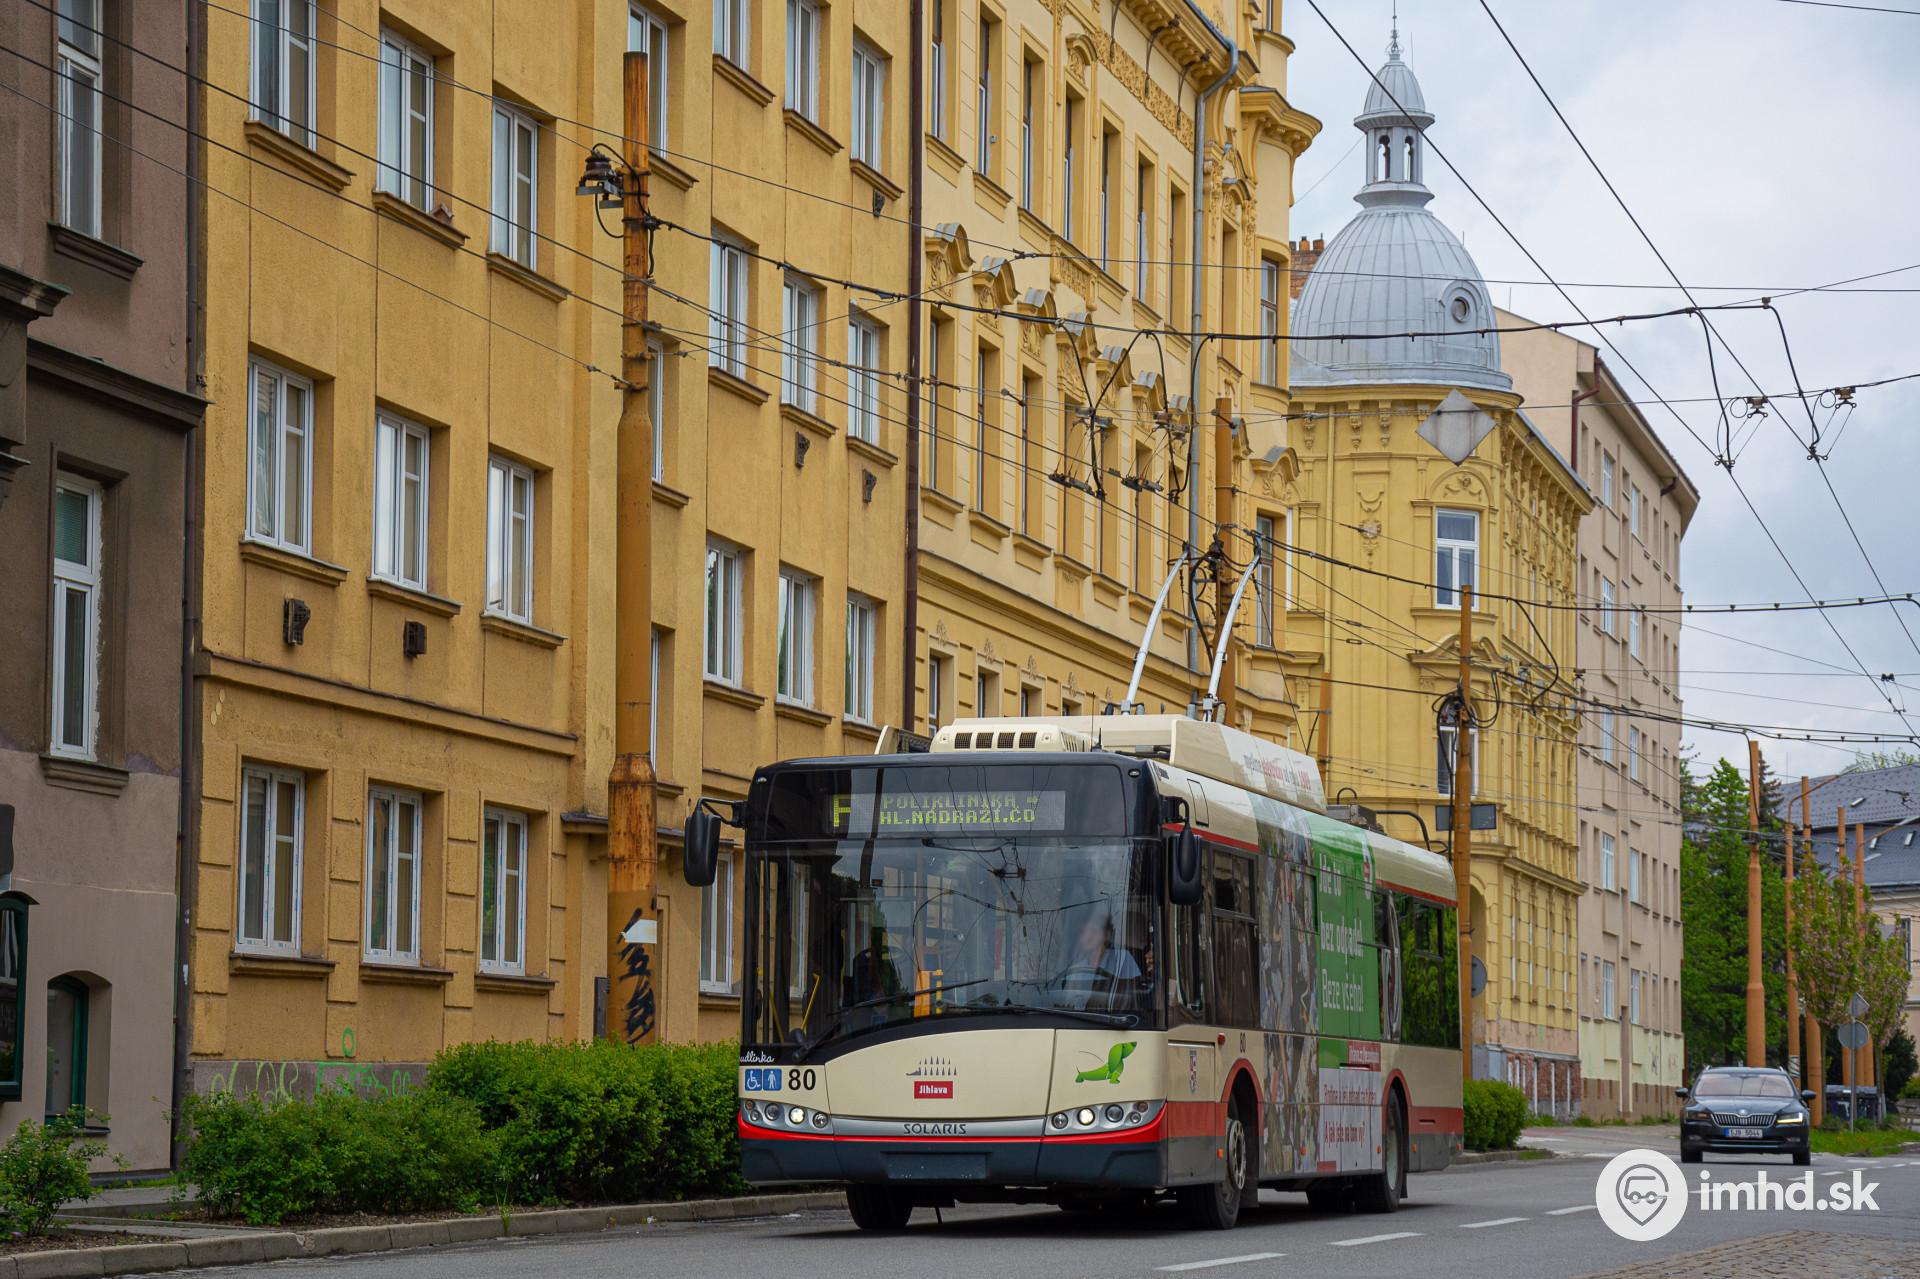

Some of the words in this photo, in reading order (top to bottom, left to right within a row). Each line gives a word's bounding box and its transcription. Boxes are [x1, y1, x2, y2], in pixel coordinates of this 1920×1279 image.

[832, 794, 852, 828] F
[883, 794, 1016, 808] POLIKLINIKA
[1319, 853, 1332, 895] Jde
[1333, 860, 1342, 897] to
[1320, 911, 1335, 952] bez
[1321, 968, 1341, 1009] Beze
[1240, 1031, 1247, 1054] 80
[788, 1068, 816, 1091] 80
[919, 1084, 949, 1095] Jihlava
[903, 1123, 967, 1135] SOLARIS
